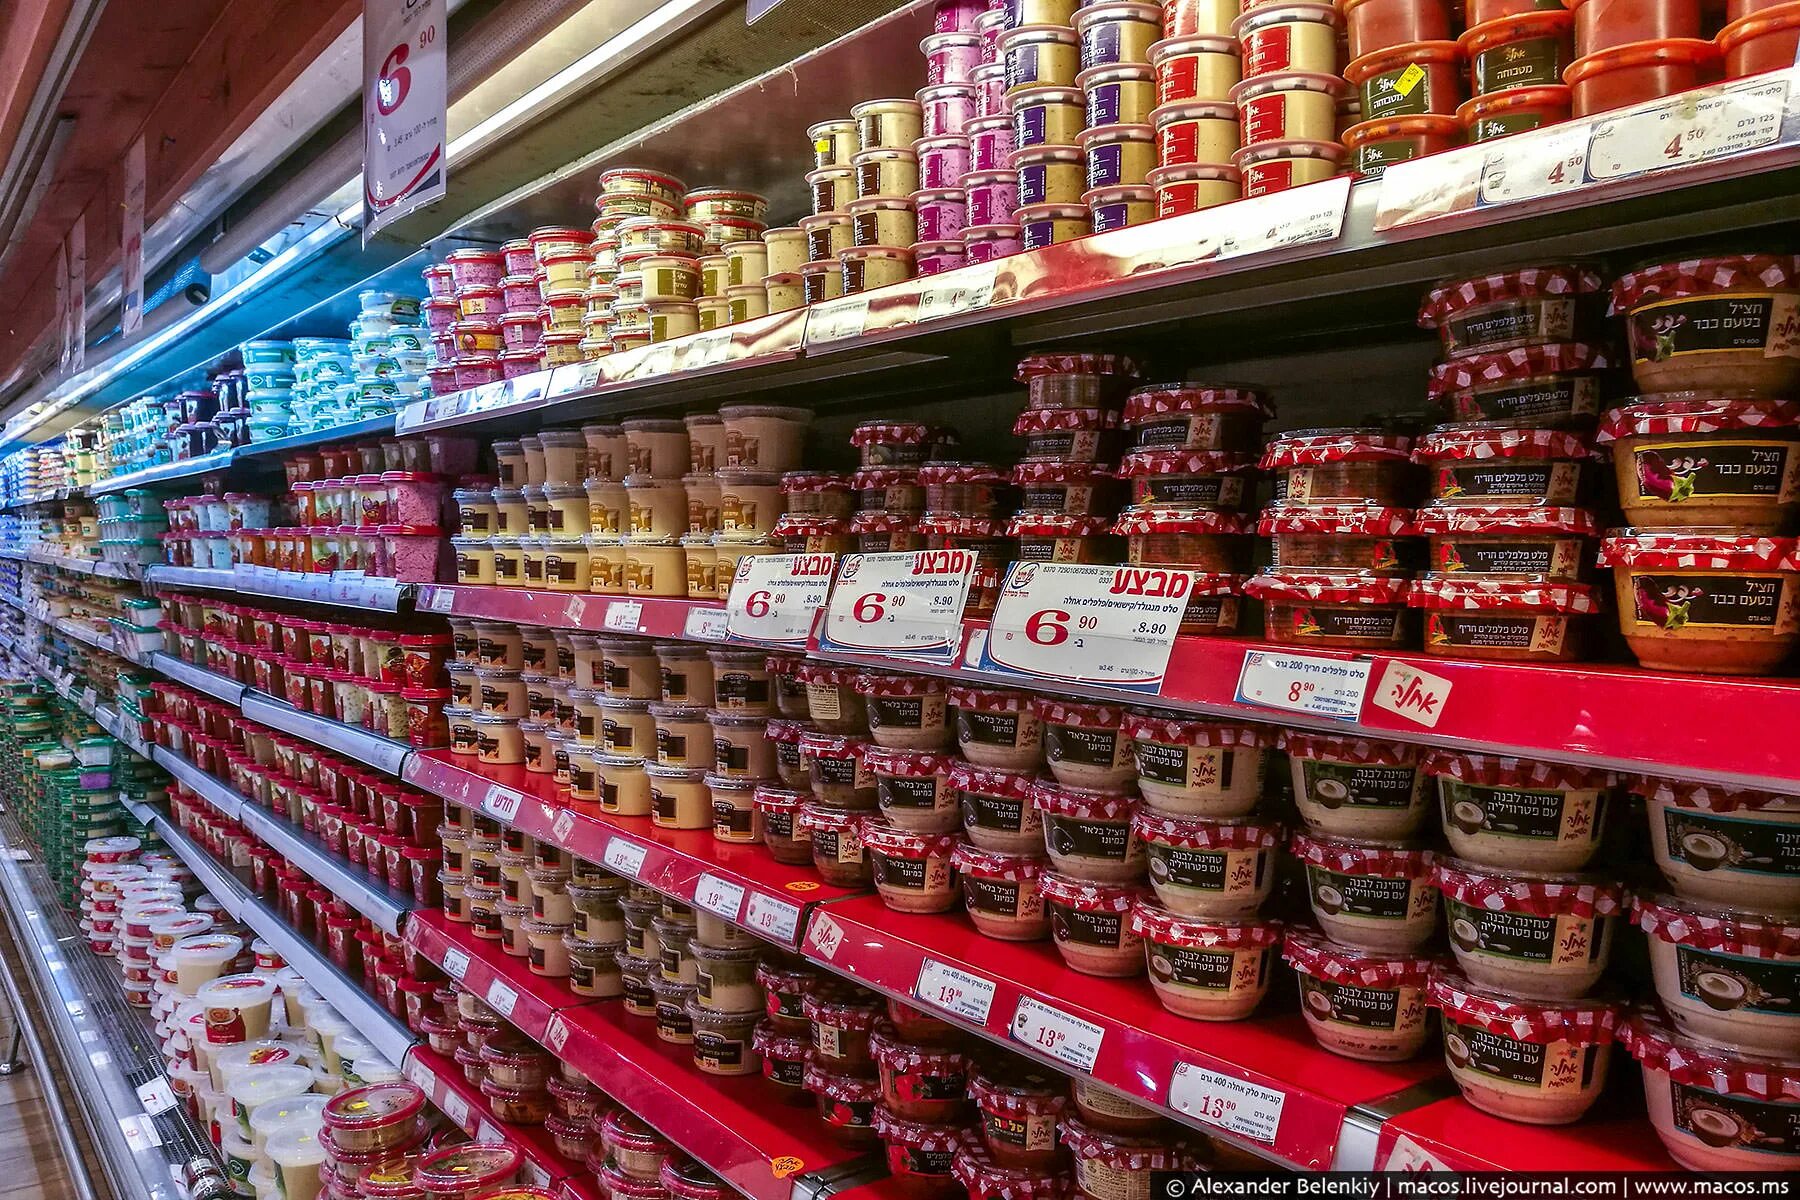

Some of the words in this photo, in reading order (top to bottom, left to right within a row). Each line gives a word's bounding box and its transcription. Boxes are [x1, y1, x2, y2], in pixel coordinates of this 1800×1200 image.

[419, 25, 435, 48] 90
[1496, 65, 1533, 79] מטבוחה
[377, 43, 411, 116] 6
[1738, 118, 1756, 128] גרם
[1759, 114, 1775, 124] 125
[1687, 128, 1704, 141] 50
[1664, 133, 1683, 159] 4
[1567, 156, 1583, 167] 50
[1547, 160, 1565, 184] 4
[1729, 302, 1762, 315] חציל
[1485, 318, 1516, 329] פלפלים
[1517, 314, 1535, 323] סלט
[1723, 317, 1761, 329] בטעם
[1466, 323, 1484, 335] חריף
[1693, 319, 1719, 330] כבד
[1519, 391, 1551, 403] פלפלים
[1552, 390, 1569, 399] סלט
[1497, 397, 1518, 408] חריף
[1752, 449, 1780, 462] חציל
[1715, 464, 1741, 474] כבד
[1745, 464, 1778, 475] בטעם
[1474, 474, 1494, 484] חריף
[1495, 473, 1526, 482] פלפלים
[1528, 473, 1545, 482] סלט
[1477, 552, 1497, 561] חריף
[1498, 551, 1530, 560] פלפלים
[1531, 551, 1548, 559] סלט
[791, 556, 832, 576] מבצע
[912, 551, 963, 575] מבצע
[1109, 568, 1190, 599] מבצע
[1746, 580, 1775, 593] חציל
[775, 593, 786, 604] 90
[891, 595, 906, 607] 90
[1063, 597, 1081, 606] אחלה
[1709, 594, 1735, 605] כבד
[1740, 595, 1773, 606] בטעם
[746, 590, 772, 618] 6
[853, 593, 887, 624] 6
[1163, 604, 1179, 613] סלט
[1079, 616, 1098, 630] 90
[1334, 616, 1352, 626] חריף
[1353, 617, 1380, 626] פלפלים
[1024, 609, 1071, 646] 6
[1458, 624, 1477, 634] חריף
[1478, 624, 1510, 634] פלפלים
[1512, 625, 1528, 634] סלט
[1275, 660, 1288, 668] גרם
[1289, 660, 1303, 670] 200
[1304, 665, 1321, 675] חריף
[1322, 666, 1348, 678] פלפלים
[1350, 671, 1365, 679] סלט
[1288, 681, 1302, 702] 8
[1303, 682, 1315, 692] 90
[1334, 688, 1346, 696] גרם
[1346, 689, 1358, 698] 200
[1391, 676, 1438, 715] אחלה
[1067, 730, 1089, 741] בלאדי
[1092, 734, 1112, 743] חציל
[1141, 744, 1157, 755] לבנה
[1158, 748, 1183, 757] טחינה
[1171, 759, 1183, 768] עם
[1356, 769, 1382, 778] לבנה
[1384, 770, 1412, 779] טחינה
[1398, 780, 1410, 788] עם
[493, 793, 515, 810] חדש
[1493, 792, 1520, 803] לבנה
[1525, 795, 1559, 806] טחינה
[1542, 808, 1558, 818] עם
[1080, 825, 1104, 834] בלאדי
[1106, 827, 1126, 836] חציל
[1172, 851, 1192, 862] לבנה
[1195, 855, 1223, 864] טחינה
[886, 859, 905, 868] בלאדי
[905, 862, 923, 870] חציל
[1209, 865, 1222, 874] עם
[976, 882, 996, 893] בלאדי
[1349, 878, 1373, 888] לבנה
[1376, 880, 1406, 890] טחינה
[997, 887, 1015, 896] חציל
[1391, 891, 1406, 900] עם
[706, 892, 719, 906] 13
[760, 912, 772, 927] 13
[1073, 912, 1096, 923] בלאדי
[1097, 917, 1117, 926] חציל
[1486, 911, 1512, 924] לבנה
[1516, 917, 1550, 929] טחינה
[1093, 925, 1117, 934] במיונז
[1534, 930, 1550, 941] עם
[1178, 950, 1200, 960] לבנה
[1202, 954, 1229, 963] טחינה
[1216, 964, 1229, 973] עם
[938, 985, 955, 1004] 13
[1338, 986, 1361, 998] לבנה
[1363, 992, 1394, 1001] טחינה
[1380, 1002, 1393, 1011] עם
[1036, 1026, 1056, 1048] 13
[1056, 1032, 1065, 1042] 90
[1476, 1032, 1501, 1047] לבנה
[1505, 1040, 1539, 1052] טחינה
[1523, 1054, 1539, 1064] עם
[1200, 1073, 1212, 1083] גרם
[1213, 1076, 1227, 1087] 400
[1227, 1083, 1246, 1094] אחלה
[1245, 1088, 1259, 1097] סלק
[1260, 1091, 1281, 1106] קוביות
[1200, 1095, 1224, 1118] 13
[1226, 1101, 1237, 1111] 90
[994, 1118, 1025, 1133] סלסה
